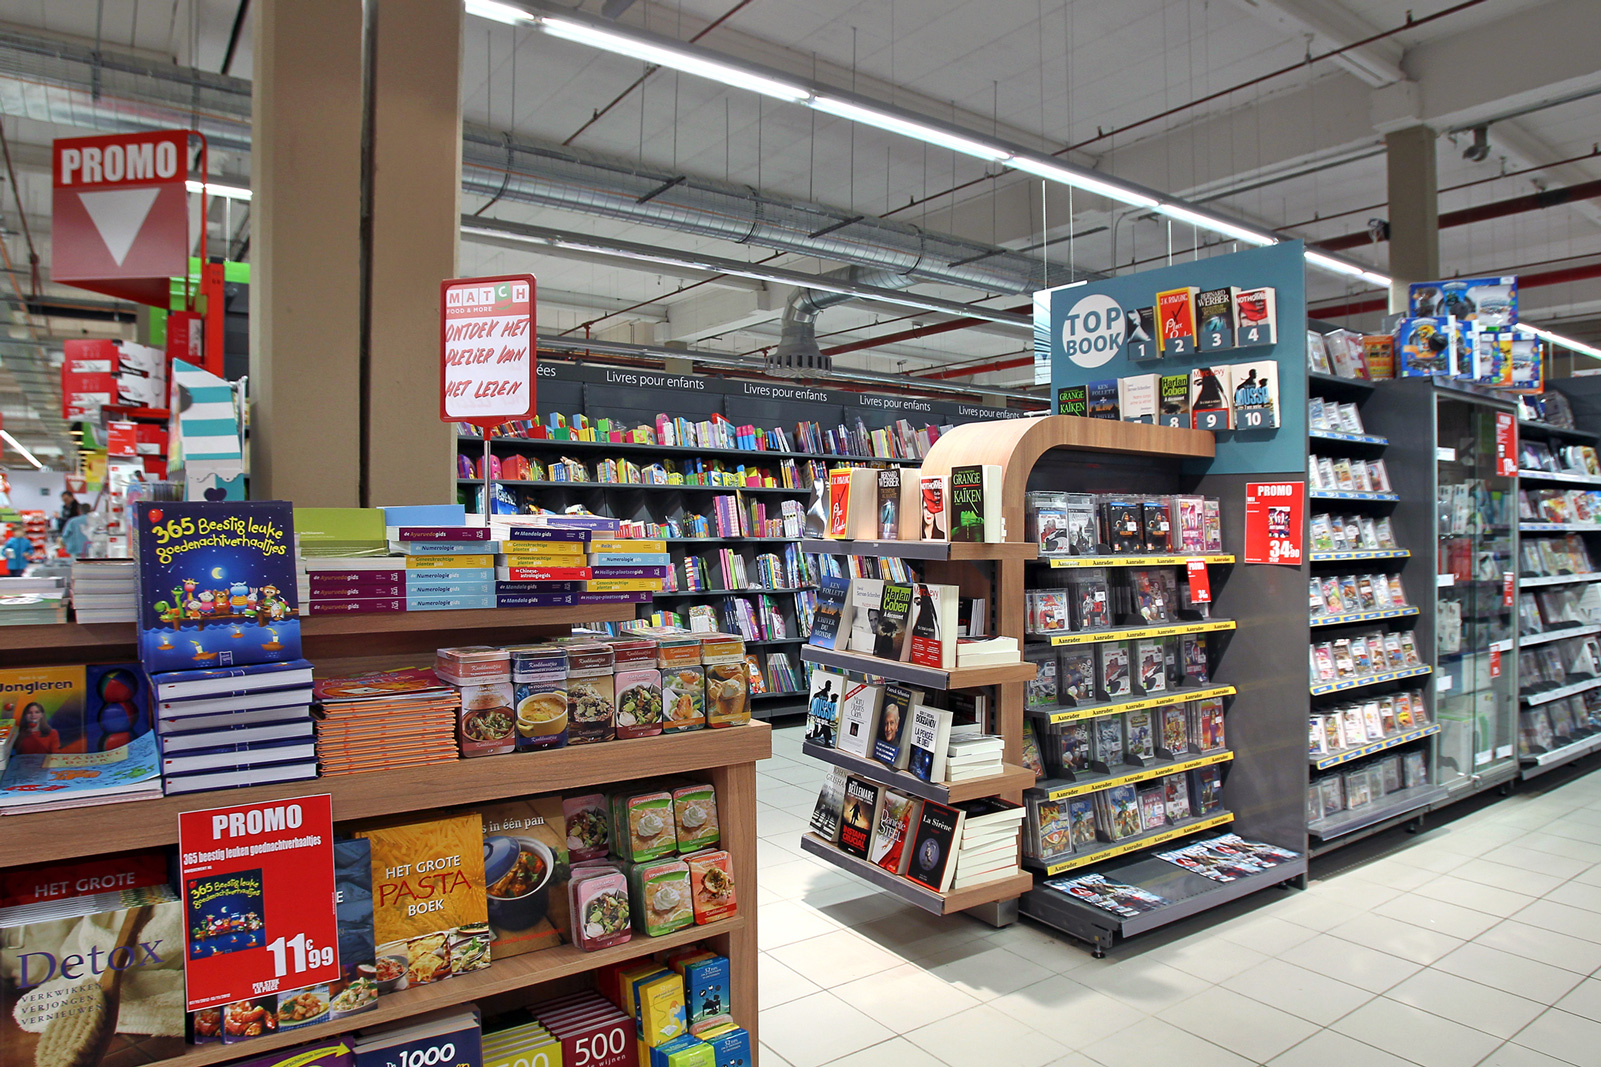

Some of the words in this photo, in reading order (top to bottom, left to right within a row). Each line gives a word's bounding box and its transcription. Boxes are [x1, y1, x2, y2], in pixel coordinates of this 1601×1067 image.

[61, 141, 177, 184] PROMO
[449, 285, 526, 304] MATCH
[1198, 294, 1230, 307] WERBER
[1201, 290, 1226, 300] BERNARD
[1066, 307, 1121, 336] TOP
[446, 319, 499, 342] ONTDEK
[501, 317, 530, 337] HET
[1248, 328, 1259, 341] 4
[1066, 332, 1122, 356] BOOK
[1175, 339, 1184, 352] 2
[1212, 333, 1222, 346] 3
[496, 345, 527, 364] VAN
[1138, 344, 1145, 356] 1
[1193, 369, 1209, 378] Marc
[1210, 368, 1224, 378] Levy
[606, 371, 637, 384] Livres
[639, 376, 665, 387] pour
[667, 377, 705, 390] enfants
[1162, 376, 1188, 388] Harlan
[446, 379, 472, 398] HET
[474, 379, 522, 399] LEZEN
[744, 383, 770, 396] Livres
[772, 388, 793, 399] pour
[795, 388, 828, 402] enfants
[1059, 390, 1085, 401] GRANGE
[1092, 388, 1116, 396] FOLLETT
[1162, 386, 1187, 397] Coben
[859, 395, 882, 407] Livres
[884, 399, 902, 409] pour
[903, 400, 931, 412] enfants
[958, 406, 978, 417] Livres
[979, 410, 995, 419] pour
[996, 409, 1020, 420] enfants
[1244, 412, 1262, 426] 10
[1170, 417, 1179, 428] 8
[1206, 414, 1217, 428] 9
[878, 478, 899, 488] WERBER
[952, 472, 981, 485] GRANGE
[953, 487, 982, 503] KAÏKEN
[1257, 485, 1292, 496] PROMO
[152, 517, 195, 544] 365
[198, 516, 246, 535] Beestig
[248, 516, 283, 539] leuke
[155, 534, 287, 564] goedenachtverhaaltjes
[1269, 540, 1290, 558] 34
[1289, 549, 1300, 558] 90
[822, 587, 845, 597] FOLLETT
[830, 581, 840, 589] KEN
[884, 587, 912, 601] Harlan
[913, 587, 926, 597] Marc
[926, 589, 939, 600] Levy
[883, 599, 908, 613] Coben
[821, 623, 828, 631] DU
[814, 630, 832, 639] MONDE
[0, 681, 73, 695] Jongleren
[1125, 702, 1145, 710] Aanrader
[1057, 712, 1080, 721] Aanrader
[833, 765, 847, 778] JOHN
[1124, 774, 1144, 783] Aanrader
[1155, 767, 1174, 776] Aanrader
[825, 773, 846, 788] GRISHA
[1091, 782, 1113, 791] Aanrader
[847, 783, 875, 800] BELLEMARE
[1055, 789, 1079, 798] Aanrader
[212, 804, 303, 840] PROMO
[489, 820, 500, 832] in
[503, 818, 522, 830] één
[524, 816, 545, 832] pan
[881, 808, 906, 831] Danielle
[922, 814, 931, 823] La
[932, 819, 952, 833] Sirène
[842, 824, 867, 840] INSTANT
[878, 822, 902, 843] STEEL
[1153, 832, 1173, 842] Aanrader
[842, 833, 865, 849] CRUCIAL
[1123, 841, 1143, 852] Aanrader
[183, 852, 198, 866] 365
[198, 849, 225, 864] beestig
[225, 844, 249, 861] leuken
[250, 835, 322, 856] goednachtverhaaltjes
[1089, 852, 1111, 862] Aanrader
[385, 863, 412, 880] HET
[416, 855, 461, 873] GROTE
[1054, 861, 1077, 872] Aanrader
[35, 880, 70, 898] HET
[75, 872, 136, 892] GROTE
[190, 882, 214, 899] 365
[378, 869, 472, 908] PASTA
[408, 899, 444, 917] BOEK
[266, 933, 307, 978] 11
[308, 946, 334, 969] 99
[16, 939, 165, 990] Detox
[575, 1027, 626, 1067] 500
[399, 1043, 456, 1067] 1000
[599, 1054, 626, 1067] wijnen
